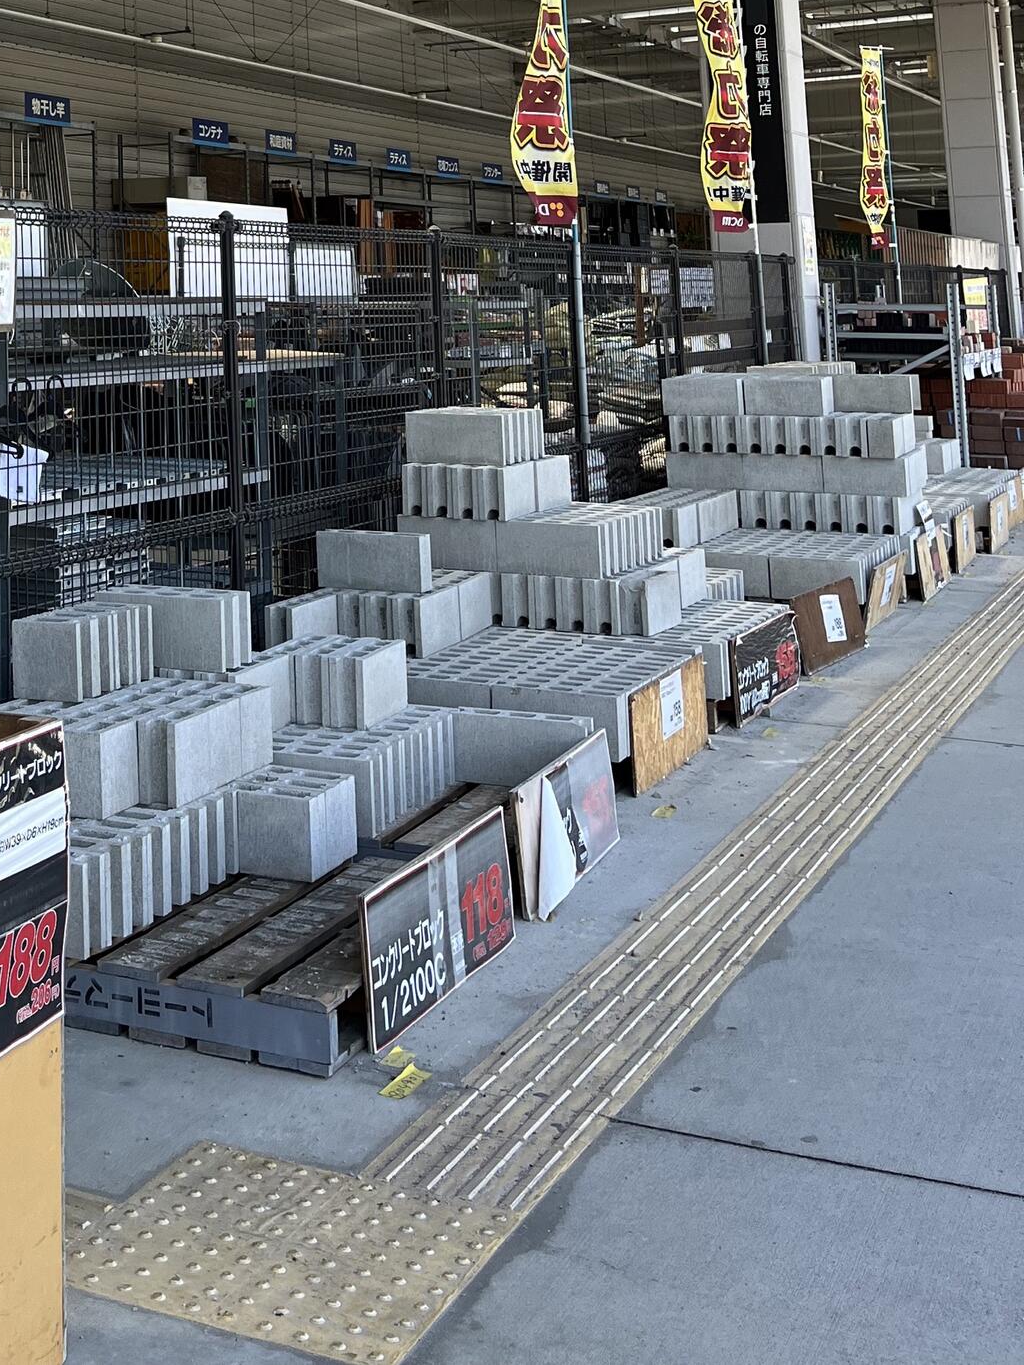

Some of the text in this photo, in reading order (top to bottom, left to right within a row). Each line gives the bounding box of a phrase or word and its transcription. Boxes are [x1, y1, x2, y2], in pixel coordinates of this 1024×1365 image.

[753, 23, 772, 117] の自転車専門店
[31, 98, 66, 119] 物干し竿
[198, 124, 223, 140] コンテナ
[333, 144, 353, 158] ラティス
[389, 152, 408, 165] ラティス
[372, 908, 445, 990] コンクリートブロック
